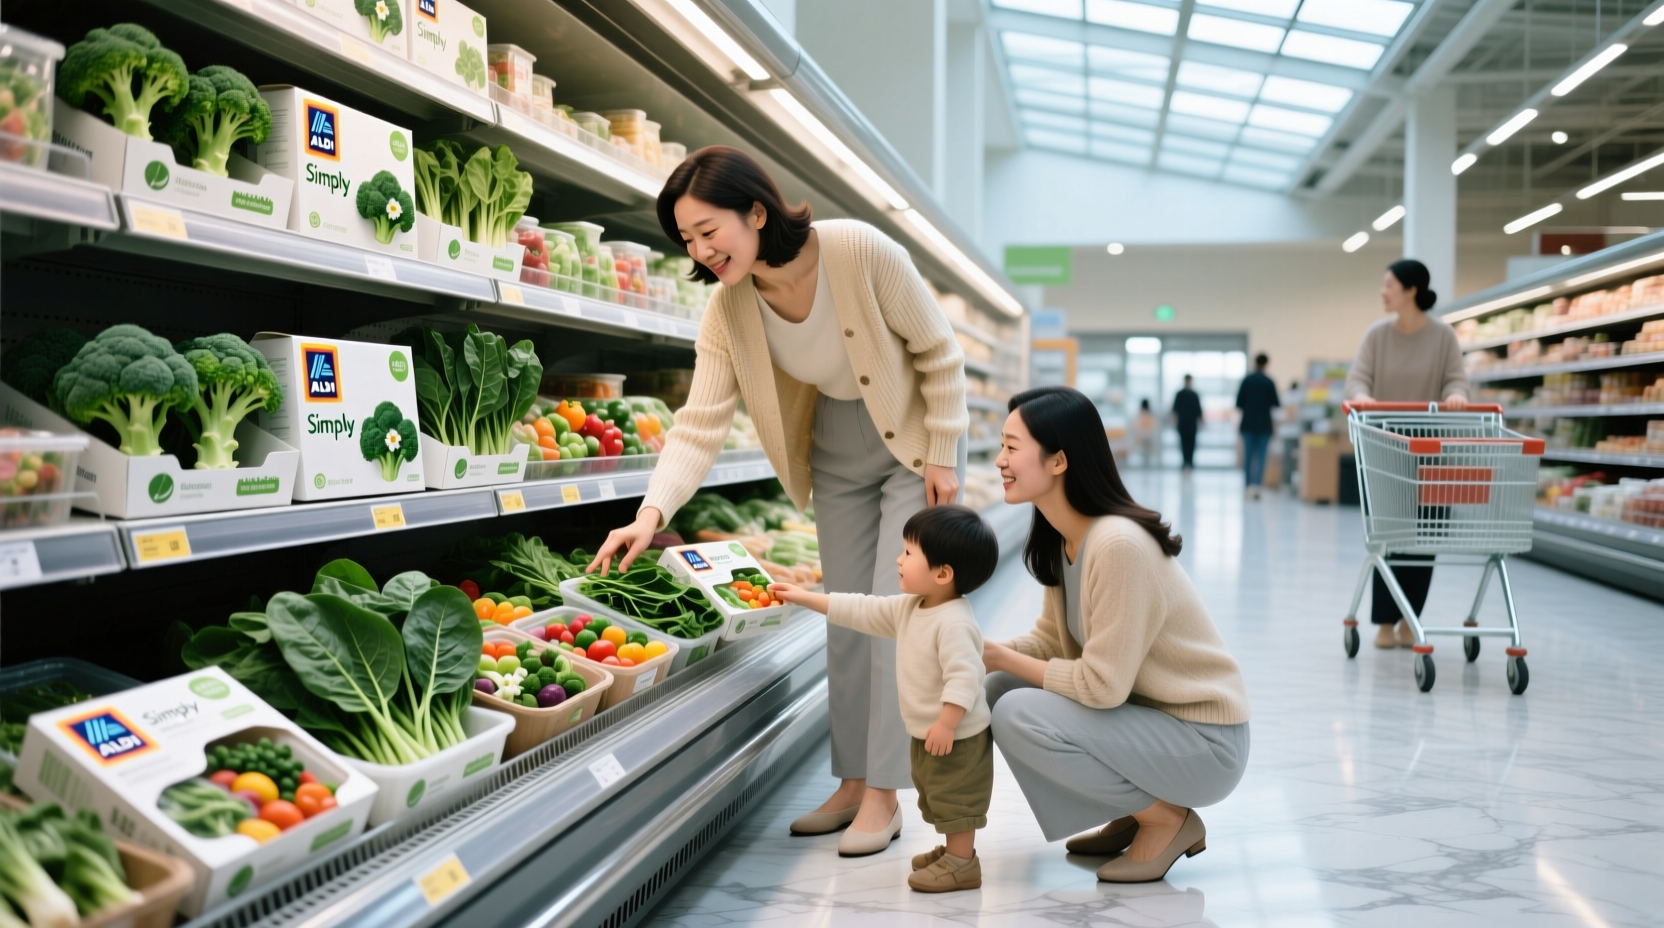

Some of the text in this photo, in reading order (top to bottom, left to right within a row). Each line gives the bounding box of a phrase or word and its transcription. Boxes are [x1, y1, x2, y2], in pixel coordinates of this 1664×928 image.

[417, 21, 447, 52] Simply
[310, 135, 335, 151] ALDI
[306, 162, 351, 198] Simply
[310, 381, 336, 393] ALDI
[307, 412, 355, 441] Simply
[99, 734, 142, 758] ALDI
